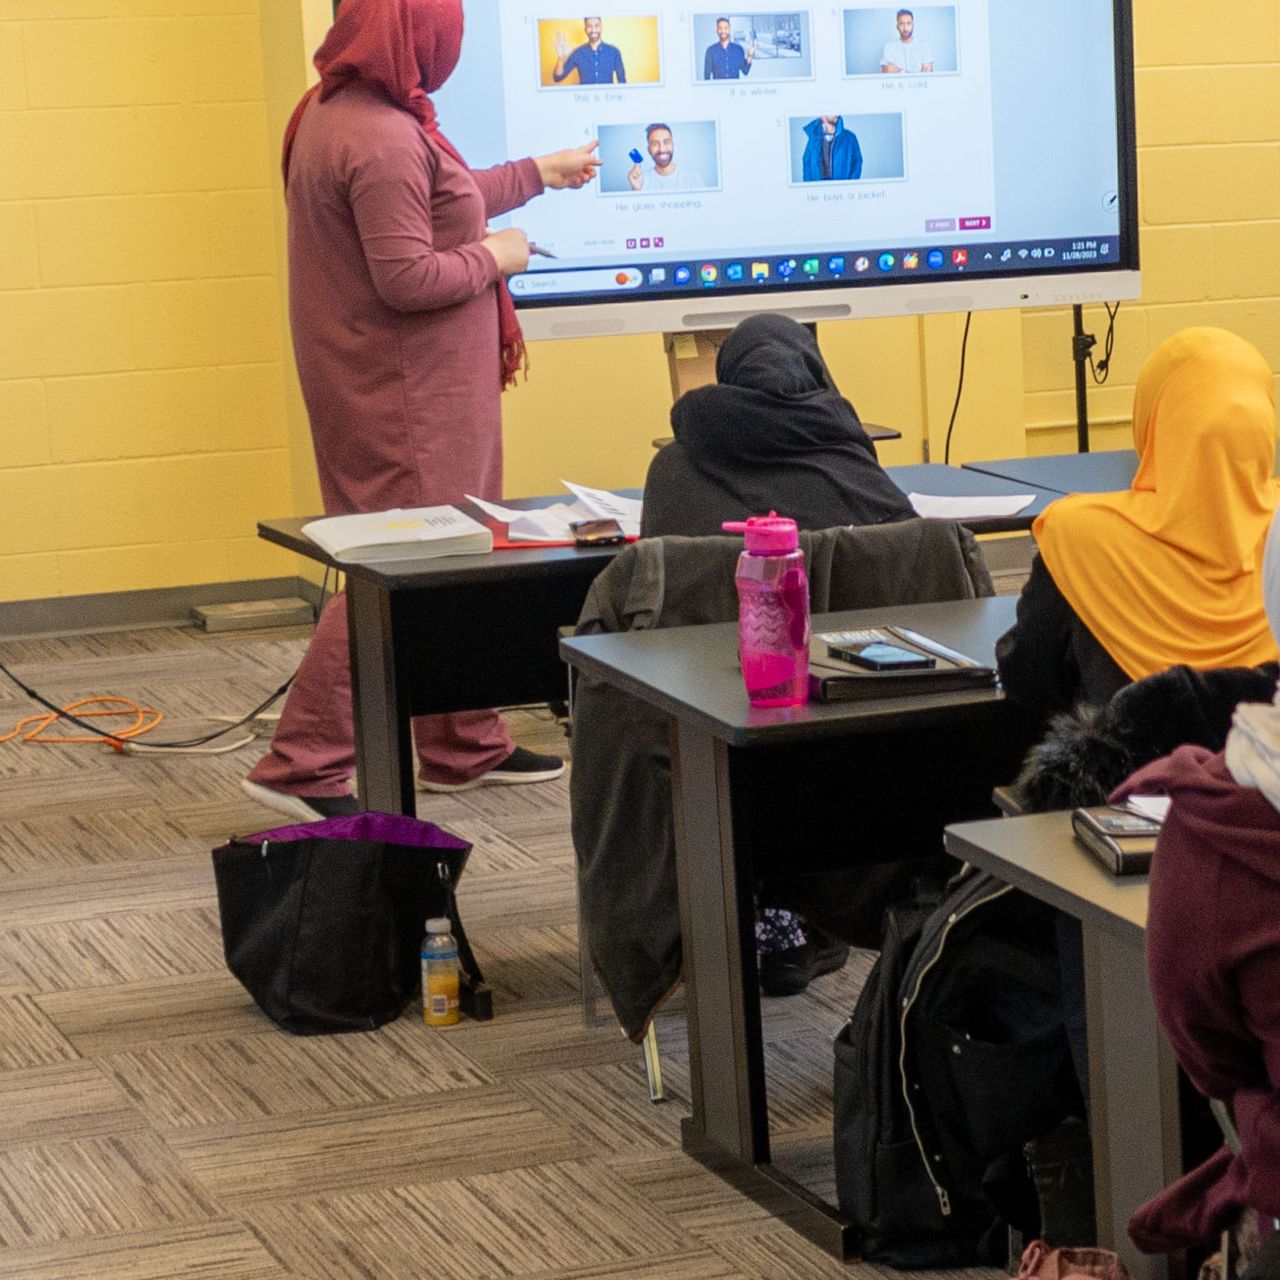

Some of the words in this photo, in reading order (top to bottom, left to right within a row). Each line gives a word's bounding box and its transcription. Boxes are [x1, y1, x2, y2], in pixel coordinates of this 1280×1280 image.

[881, 80, 894, 90] He
[806, 191, 819, 204] He
[823, 190, 844, 205] buys
[615, 199, 629, 211] He
[632, 201, 656, 213] goes
[1072, 241, 1085, 251] 1:21
[1086, 240, 1097, 250] PM
[530, 277, 558, 289] Search
